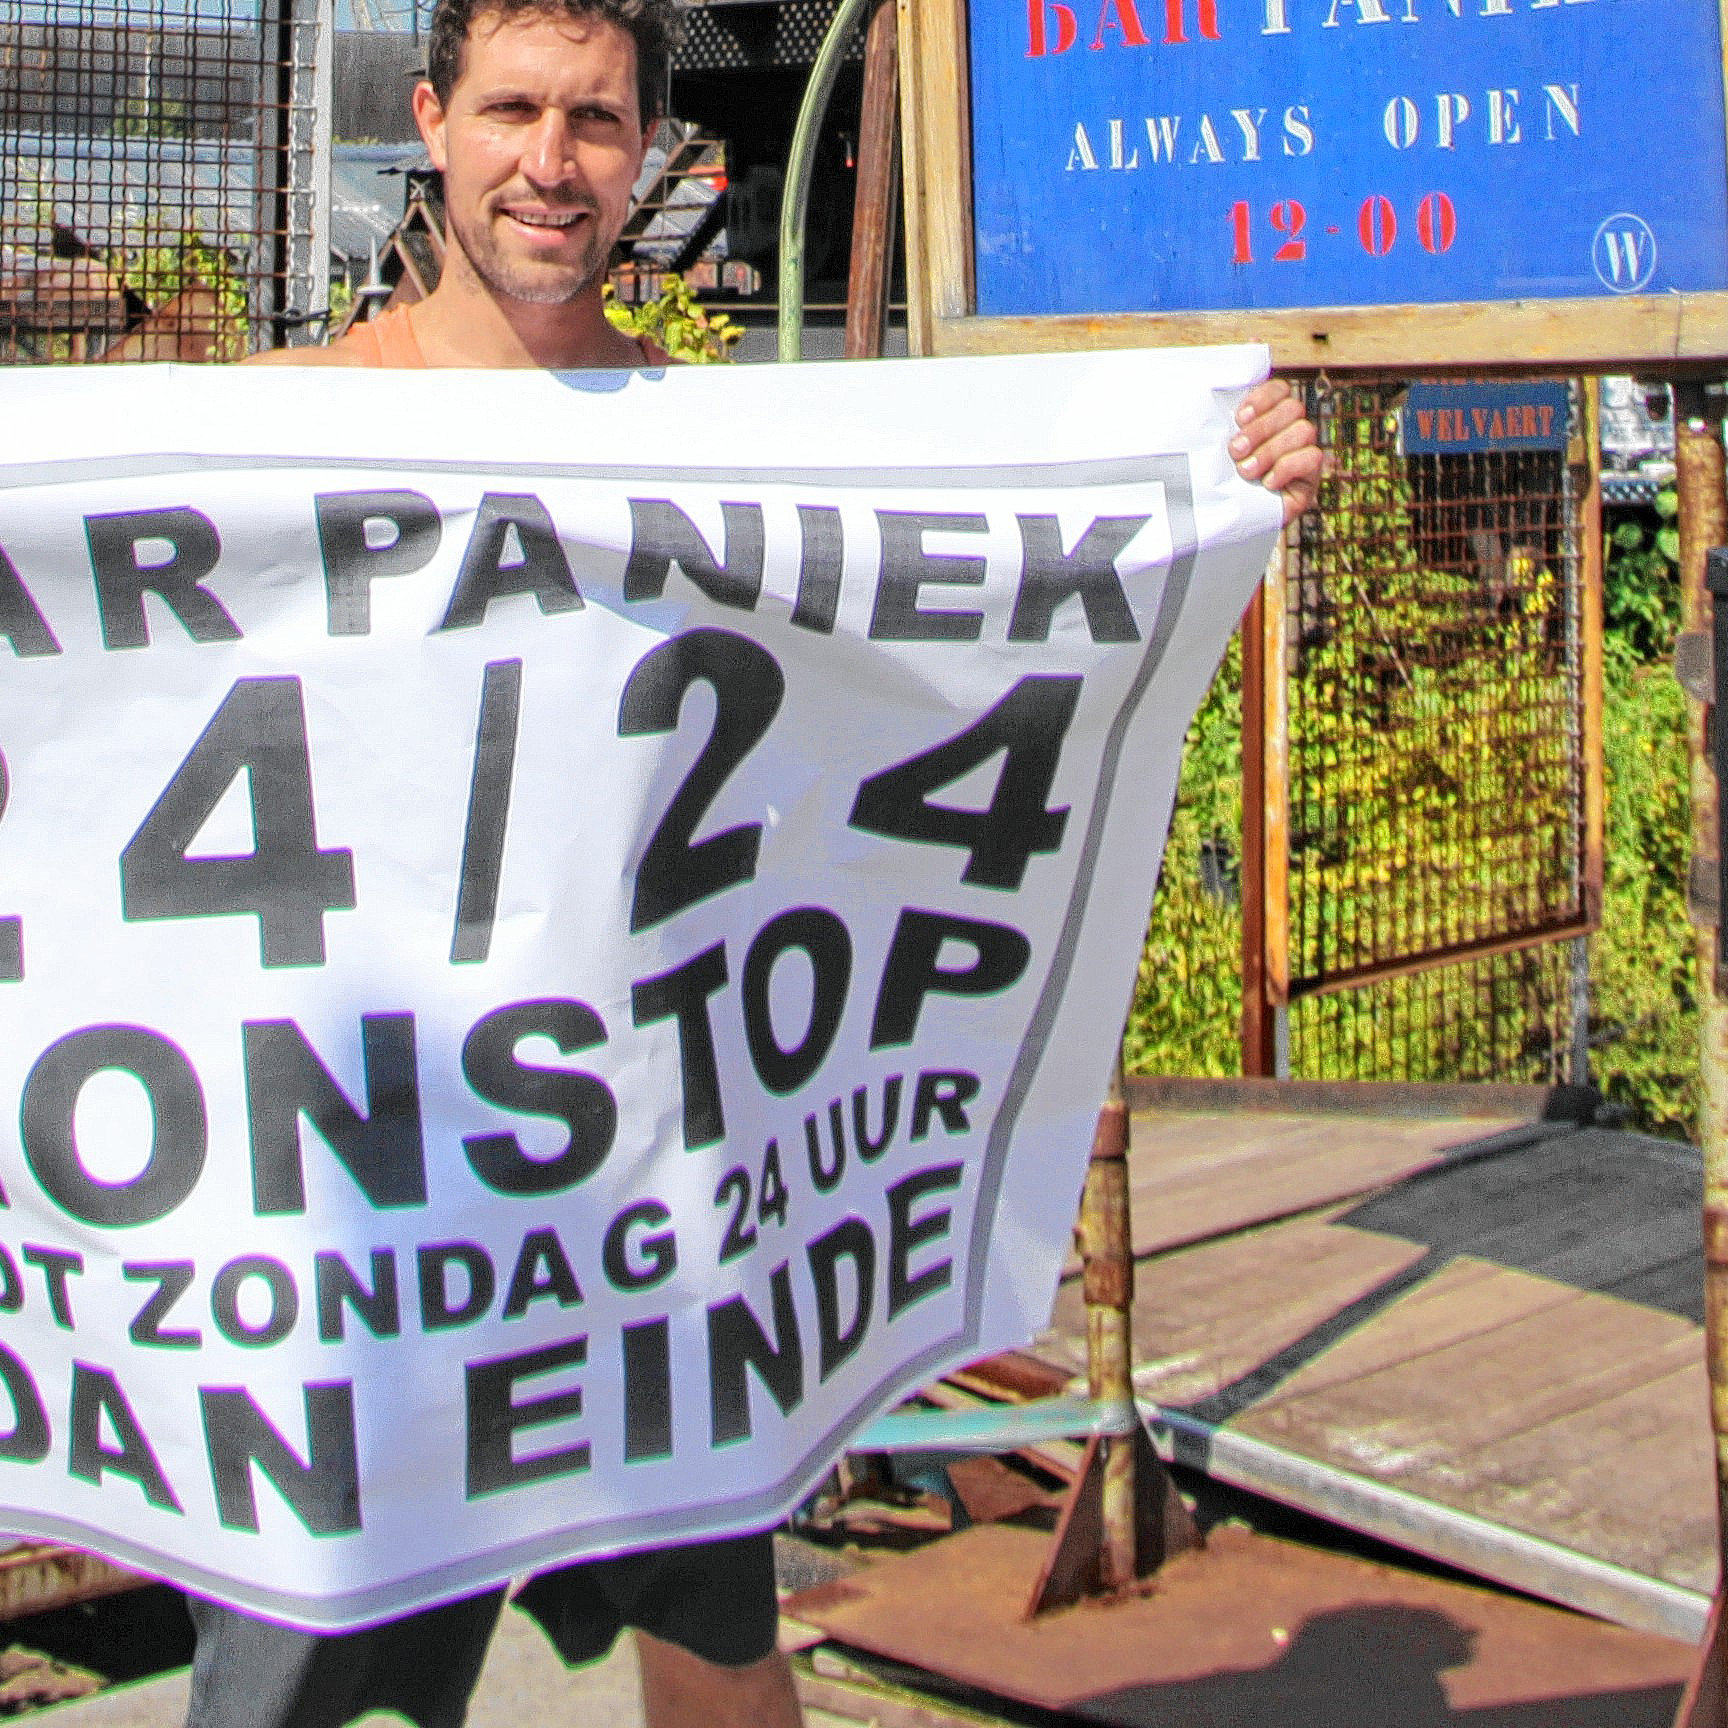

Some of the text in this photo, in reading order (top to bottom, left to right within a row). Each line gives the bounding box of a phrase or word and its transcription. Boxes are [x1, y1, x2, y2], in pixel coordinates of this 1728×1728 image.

[1064, 83, 1582, 172] ALWAYS OPEN
[312, 489, 1145, 645] PANIEK
[122, 1198, 679, 1350] ZONDAG
[714, 1136, 792, 1266] 24
[802, 1068, 983, 1196] UUR
[462, 1159, 965, 1503] EINDE
